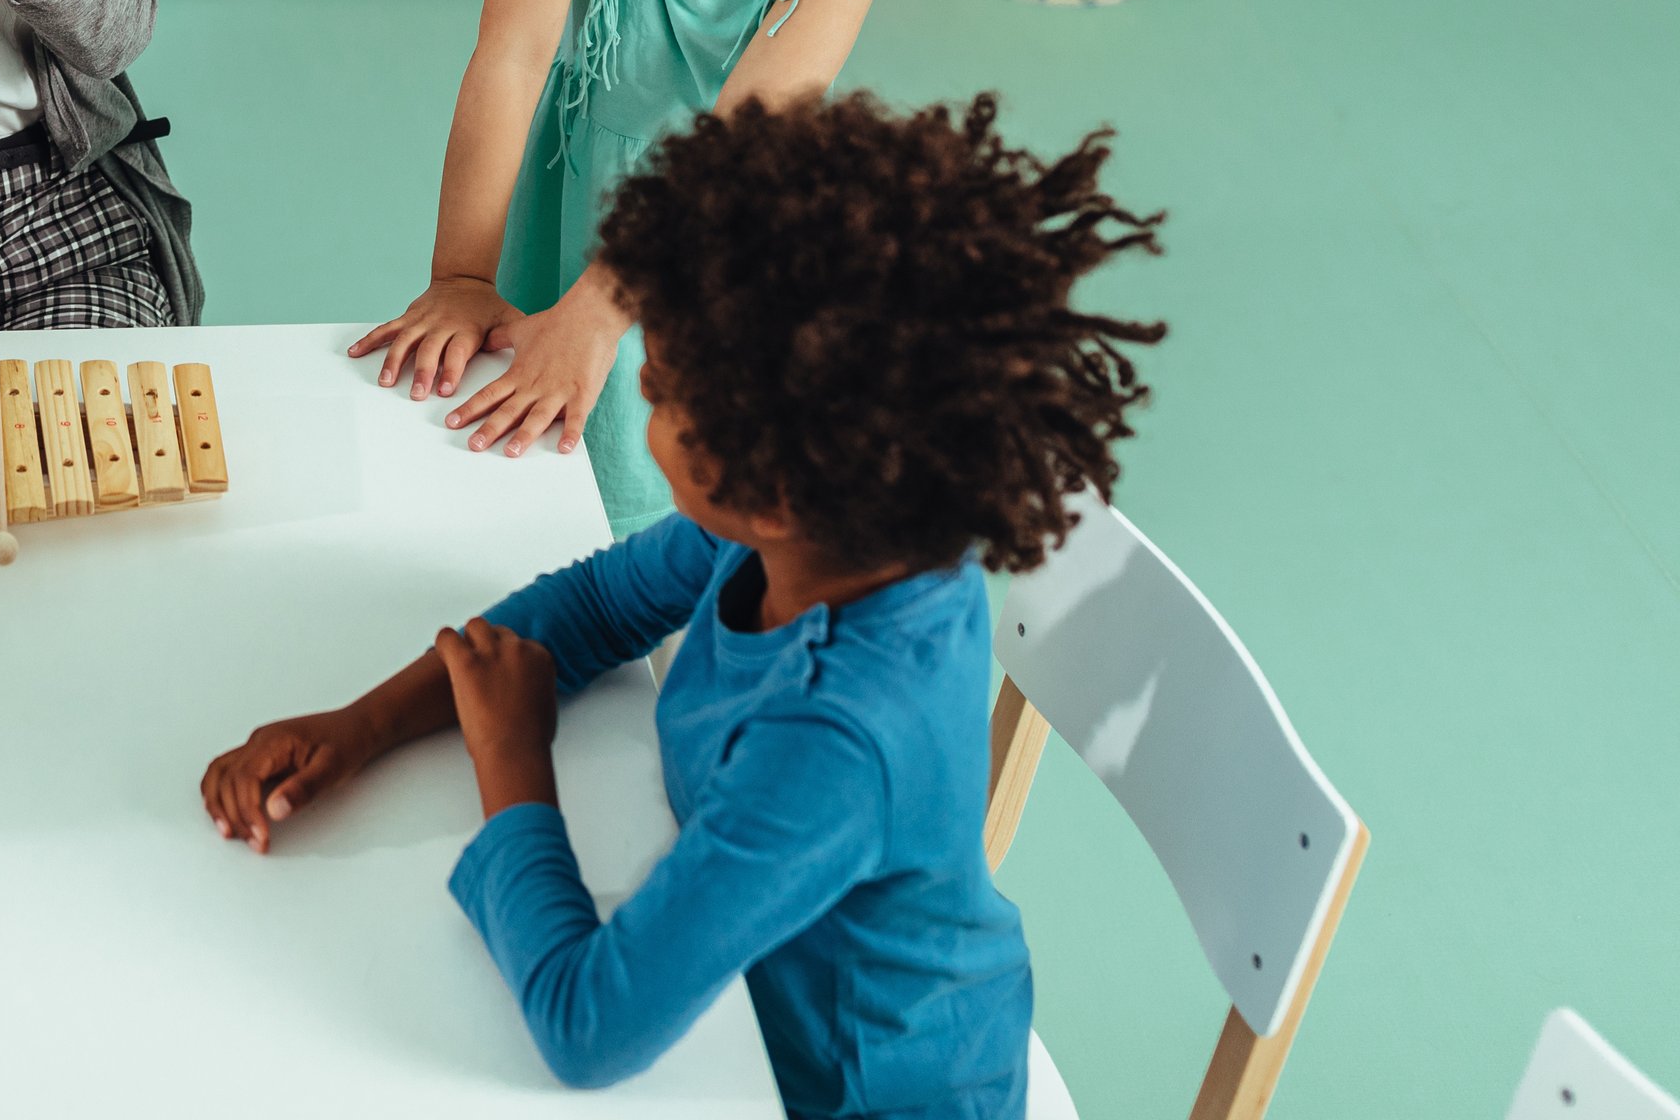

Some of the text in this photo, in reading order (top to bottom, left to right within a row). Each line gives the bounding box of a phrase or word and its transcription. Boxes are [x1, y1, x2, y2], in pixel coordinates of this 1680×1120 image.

[197, 411, 209, 422] 12
[14, 422, 26, 430] 8
[60, 420, 72, 428] 9
[105, 416, 117, 427] 10
